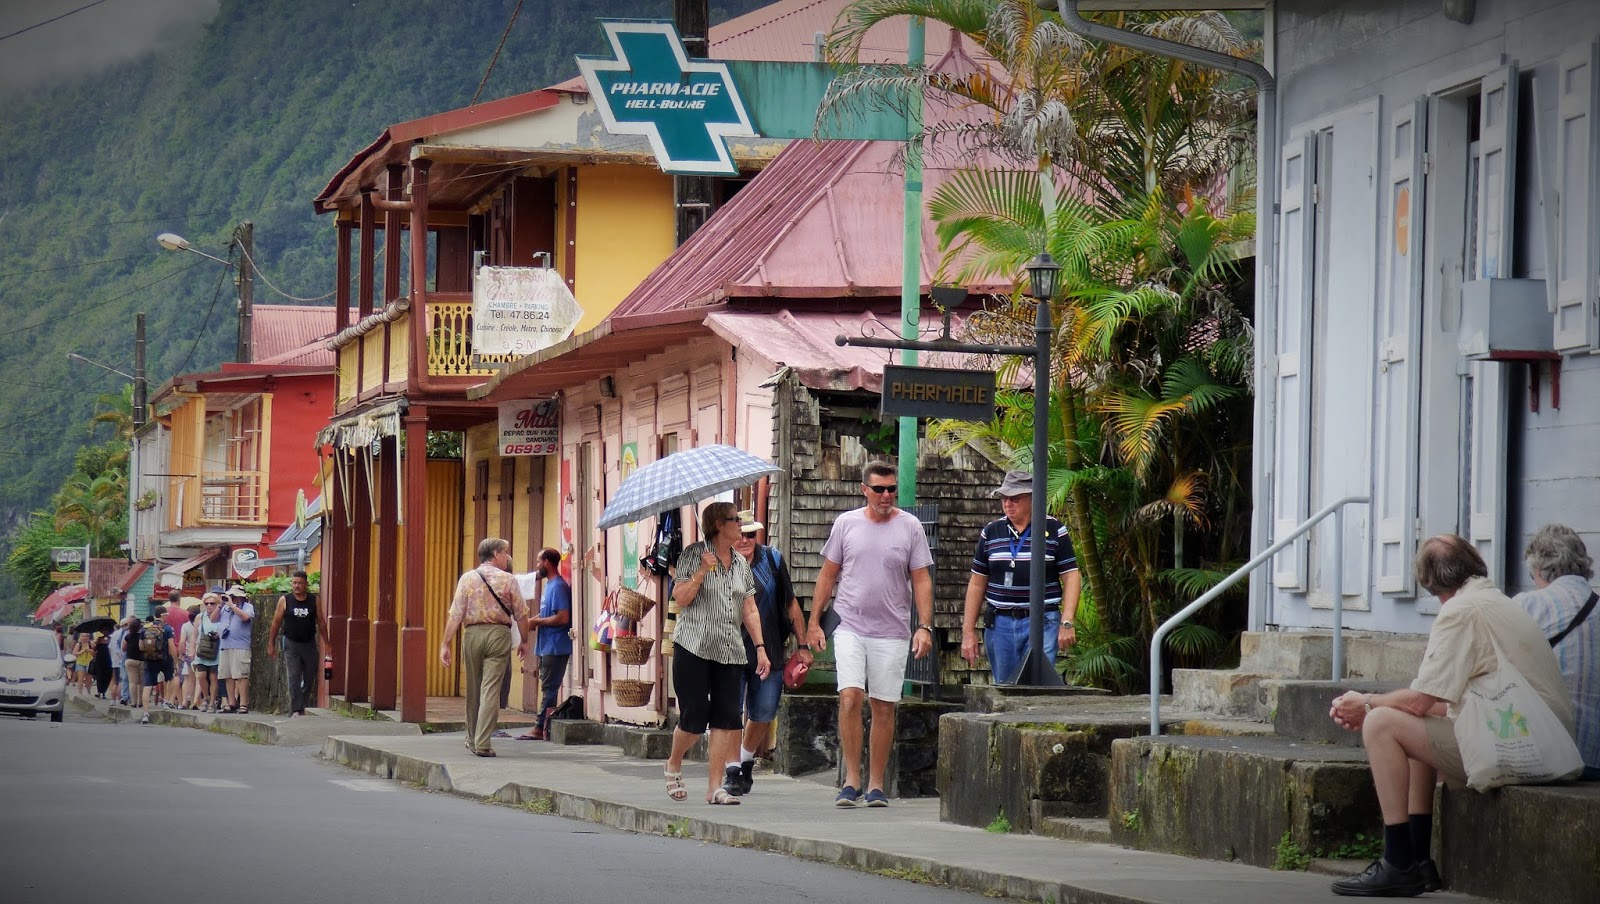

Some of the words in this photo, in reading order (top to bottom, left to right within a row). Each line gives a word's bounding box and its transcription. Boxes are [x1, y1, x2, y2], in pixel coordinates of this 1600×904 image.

[611, 82, 721, 96] PHARMACIE
[625, 99, 706, 110] HELL-BOURG
[488, 302, 518, 310] CHAMBRE
[524, 303, 549, 311] PARKING
[490, 310, 505, 319] Tél.
[510, 311, 550, 320] 47.86.24
[891, 382, 988, 405] PHARMACIE
[504, 444, 543, 455] 0693
[546, 444, 559, 454] 9
